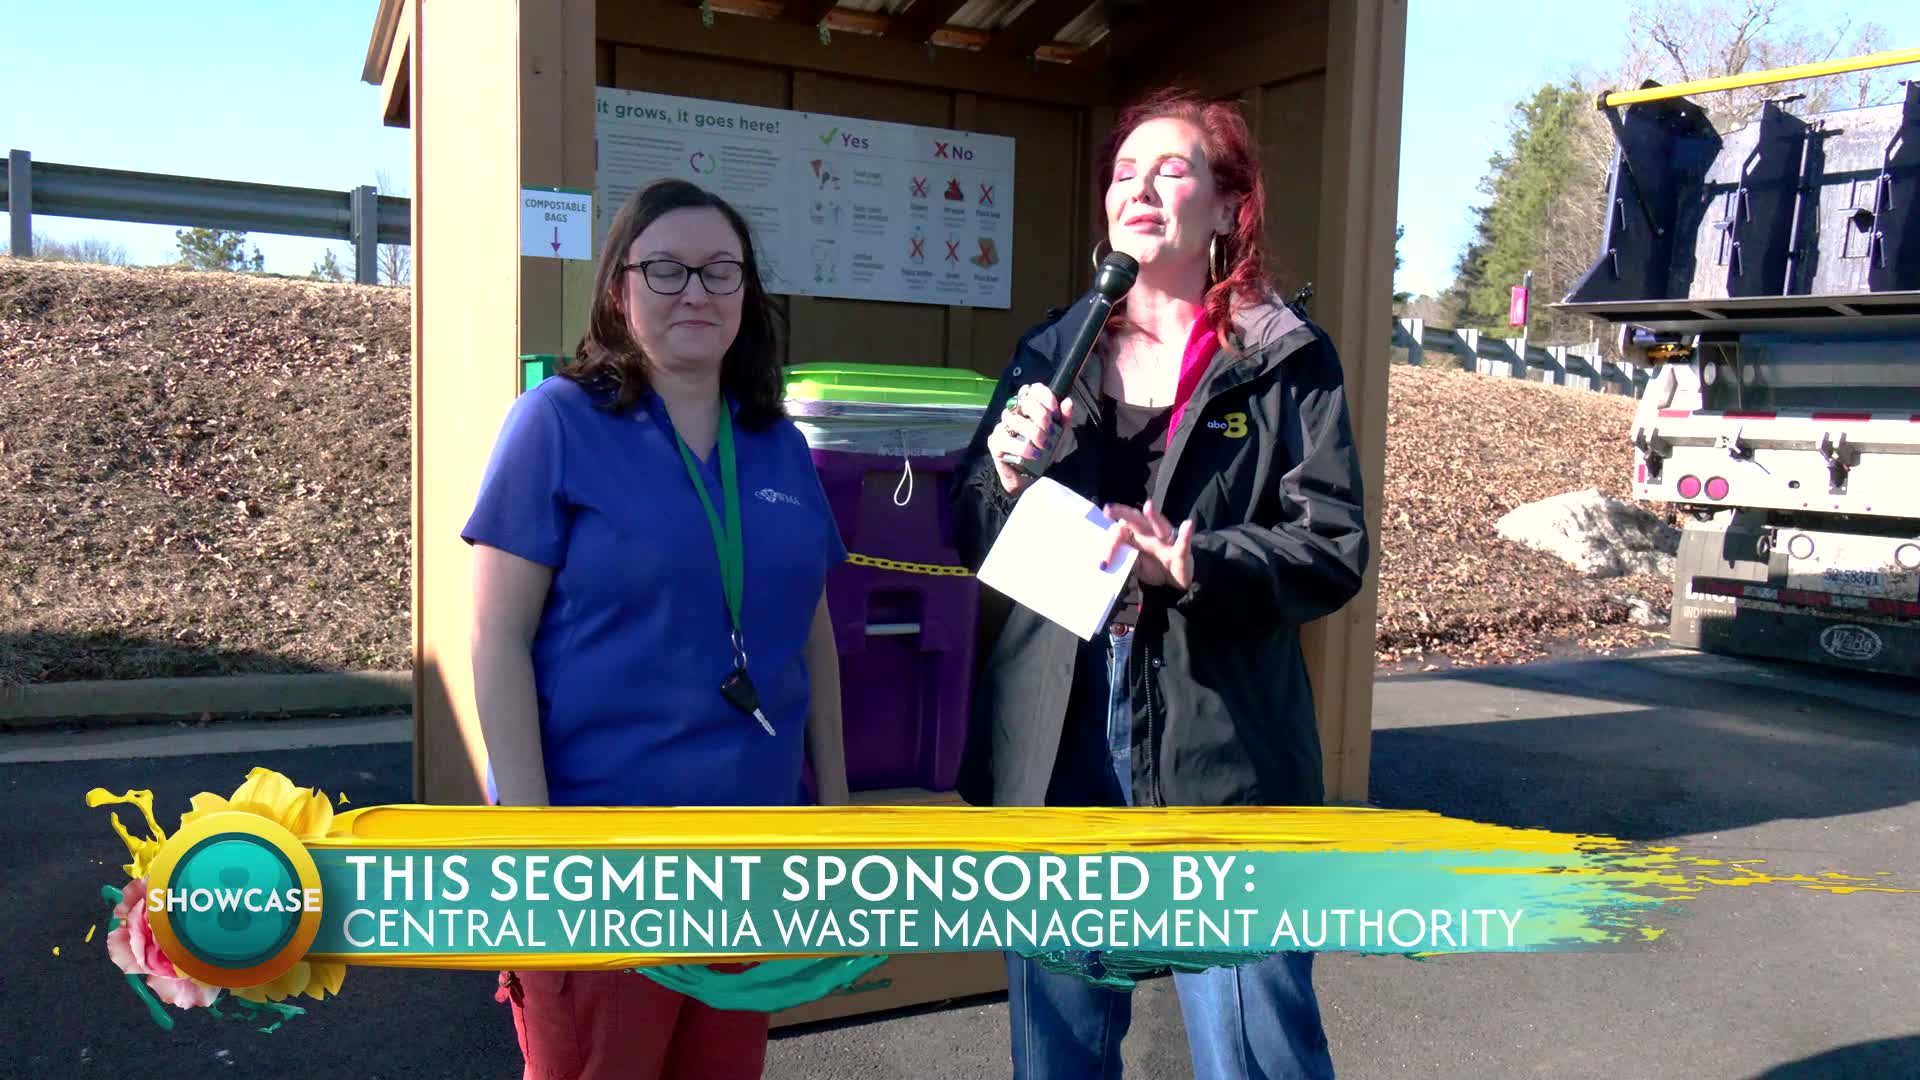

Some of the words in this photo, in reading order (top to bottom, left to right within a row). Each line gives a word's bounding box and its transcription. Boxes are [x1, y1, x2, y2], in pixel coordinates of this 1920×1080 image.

[615, 104, 671, 124] grows,
[677, 108, 689, 123] it
[694, 113, 734, 128] goes
[739, 116, 780, 134] here!
[841, 129, 869, 149] Yes
[951, 146, 974, 161] No
[525, 199, 587, 213] COMPOSTABLE
[544, 212, 568, 223] BAGS
